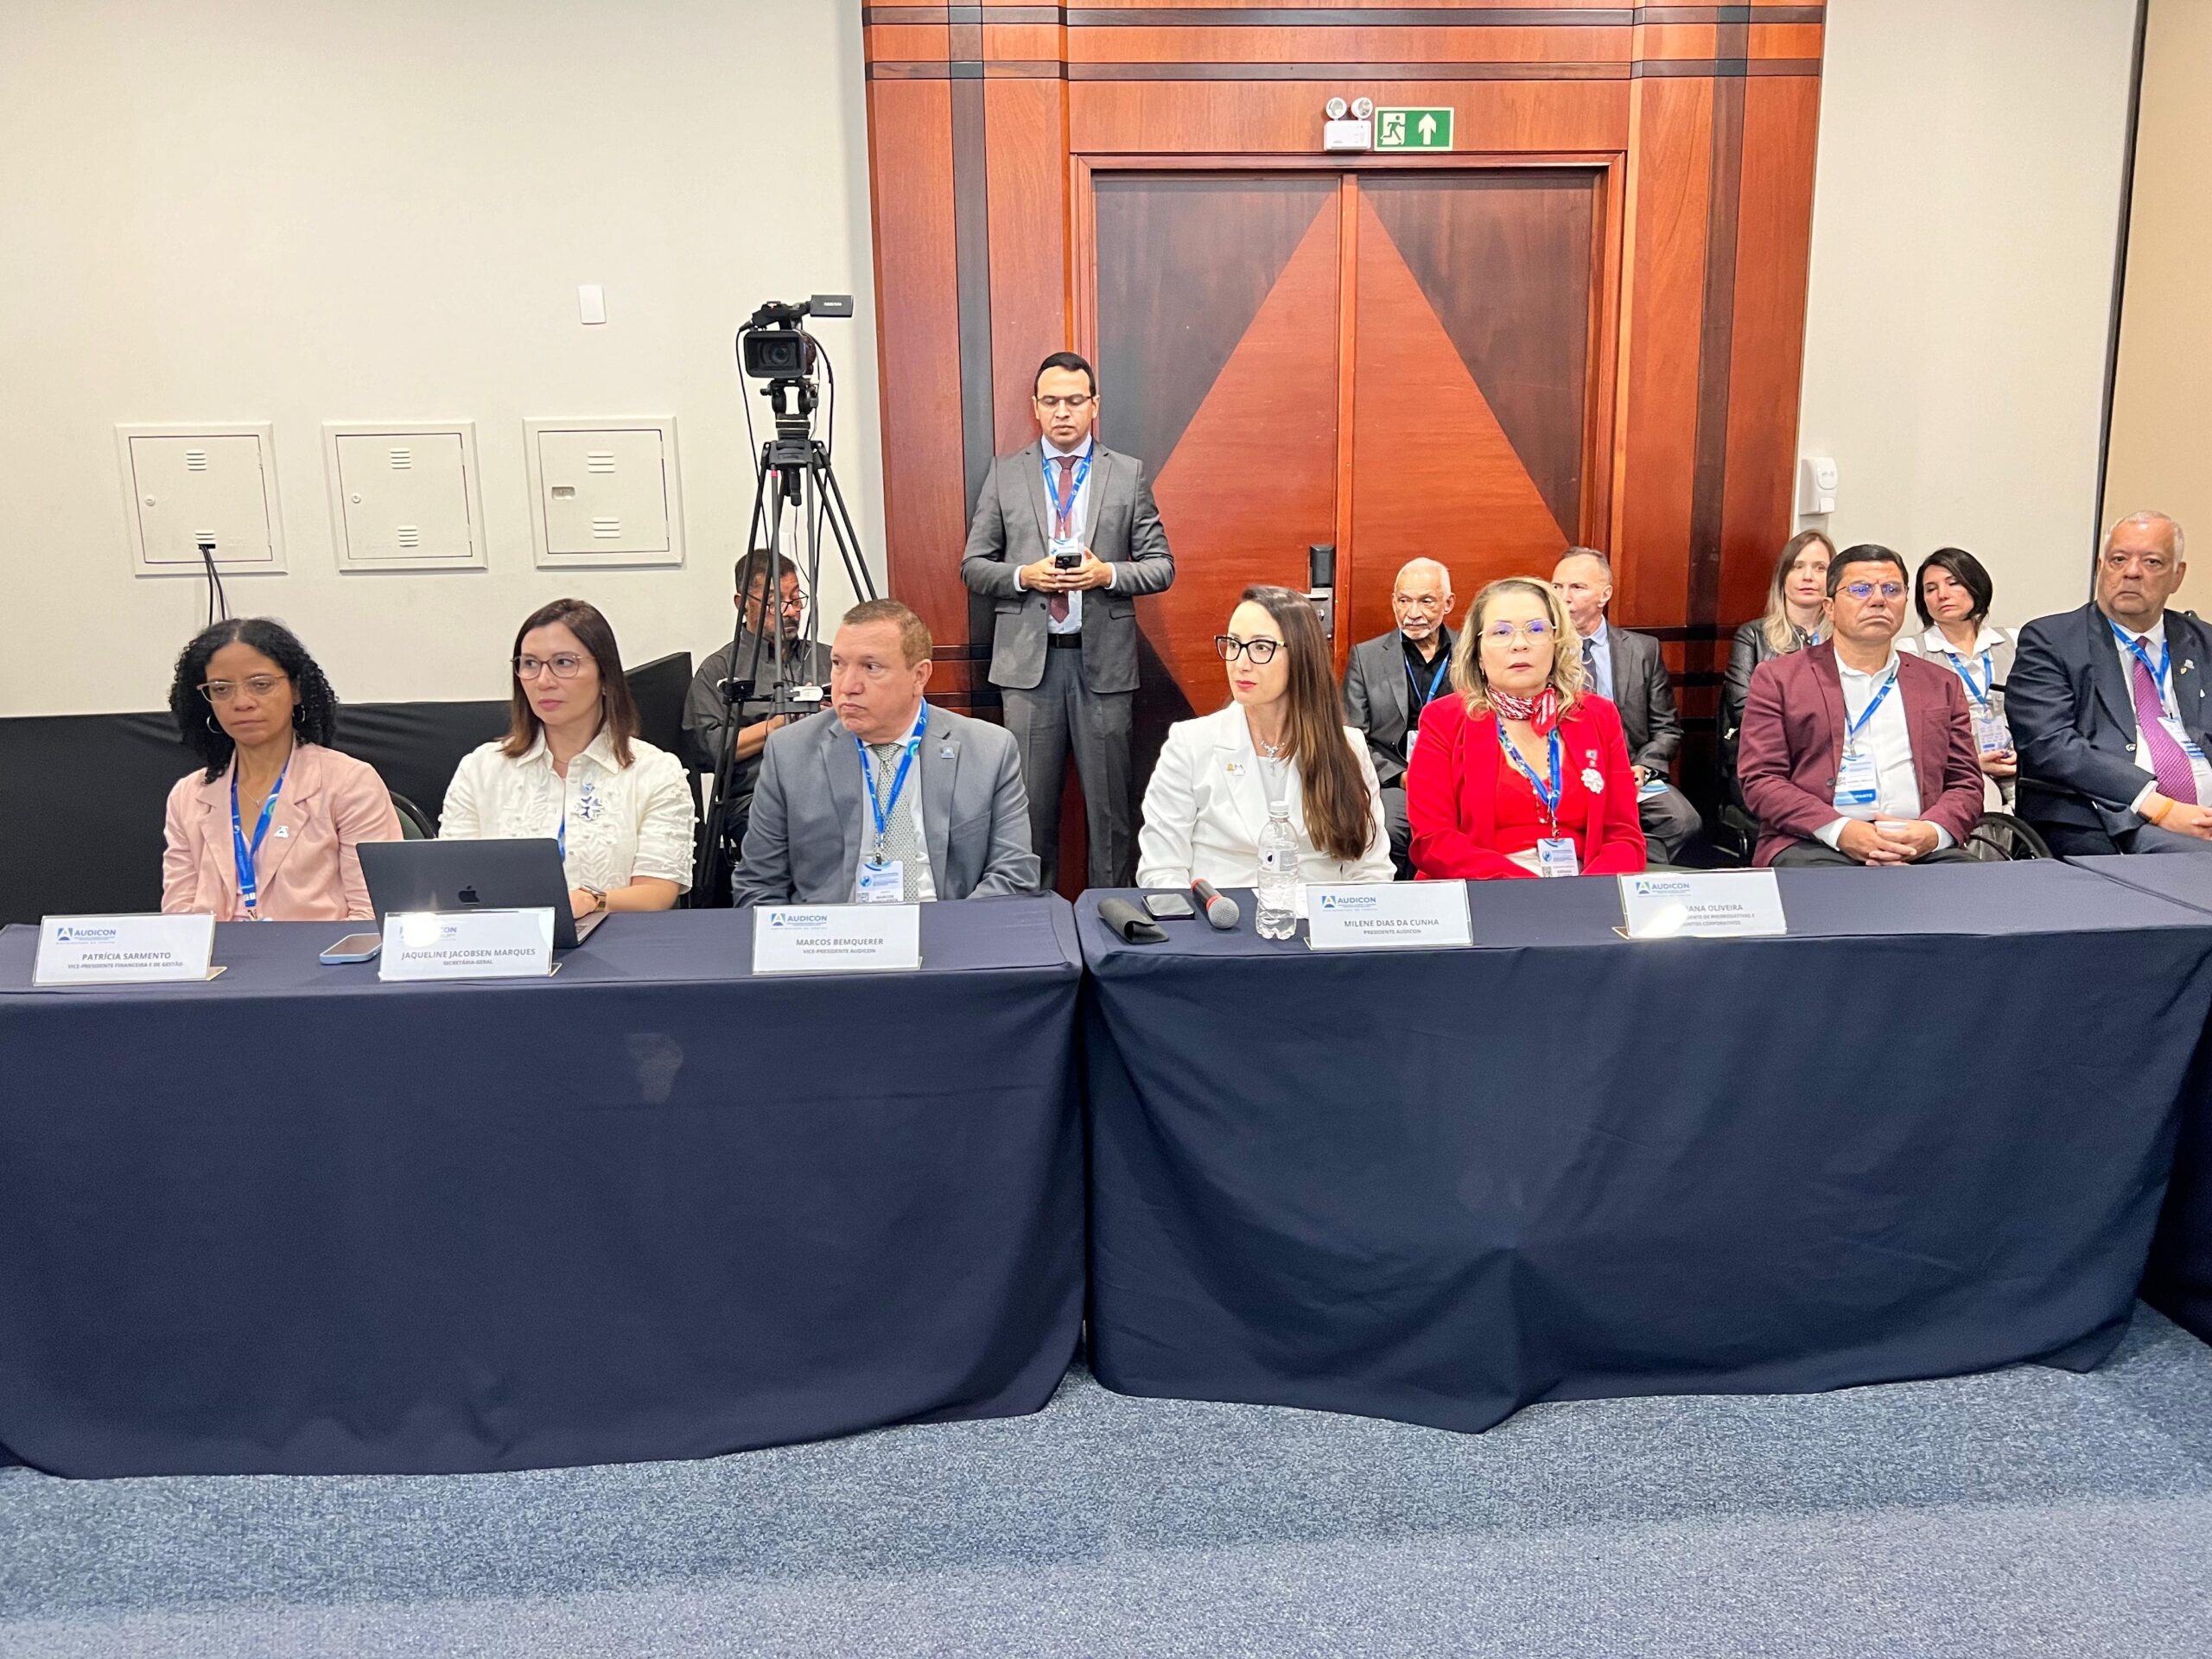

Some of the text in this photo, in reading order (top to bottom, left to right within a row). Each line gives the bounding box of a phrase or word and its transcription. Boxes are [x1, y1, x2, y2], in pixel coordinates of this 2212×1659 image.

[82, 951, 121, 961] PATRÍCIA
[401, 948, 536, 960] JAQUELINE JACOBSEN MARQUES
